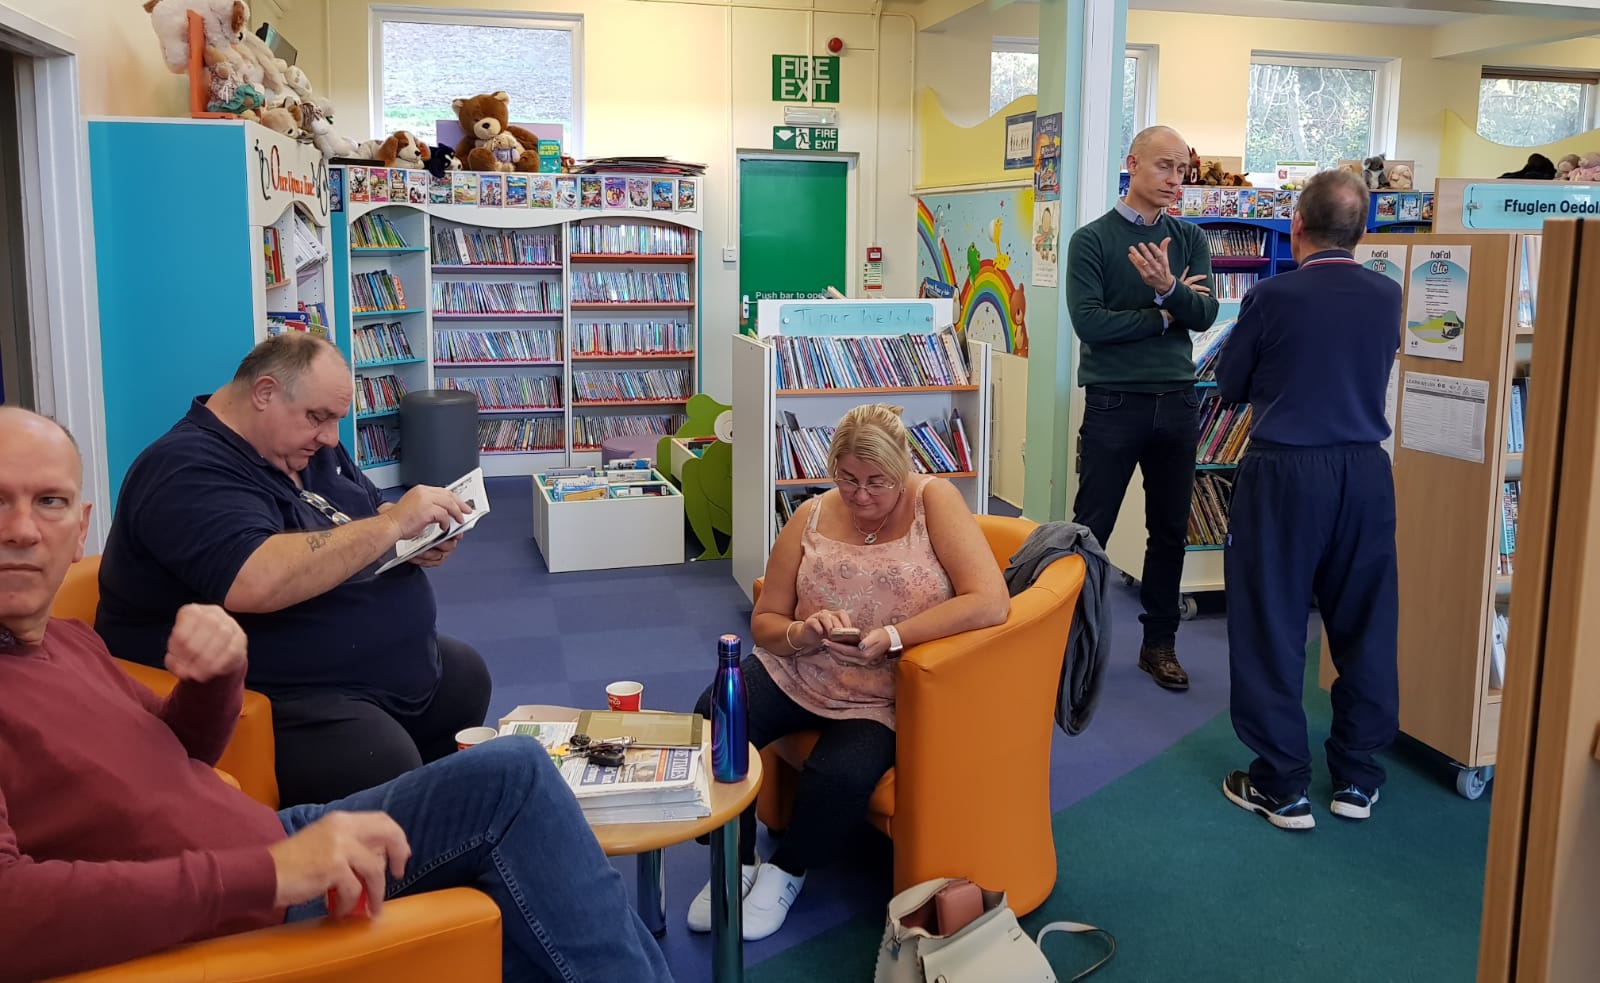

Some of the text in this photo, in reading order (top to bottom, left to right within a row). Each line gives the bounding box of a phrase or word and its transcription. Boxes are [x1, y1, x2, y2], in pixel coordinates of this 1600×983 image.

[781, 56, 830, 79] FIRE
[781, 78, 831, 100] EXIT
[815, 128, 837, 139] FIRE
[815, 140, 837, 150] EXIT
[1504, 199, 1600, 214] Ffuglen Oedol
[1430, 250, 1451, 259] hafal
[1430, 260, 1449, 275] Clic
[755, 291, 778, 299] Push
